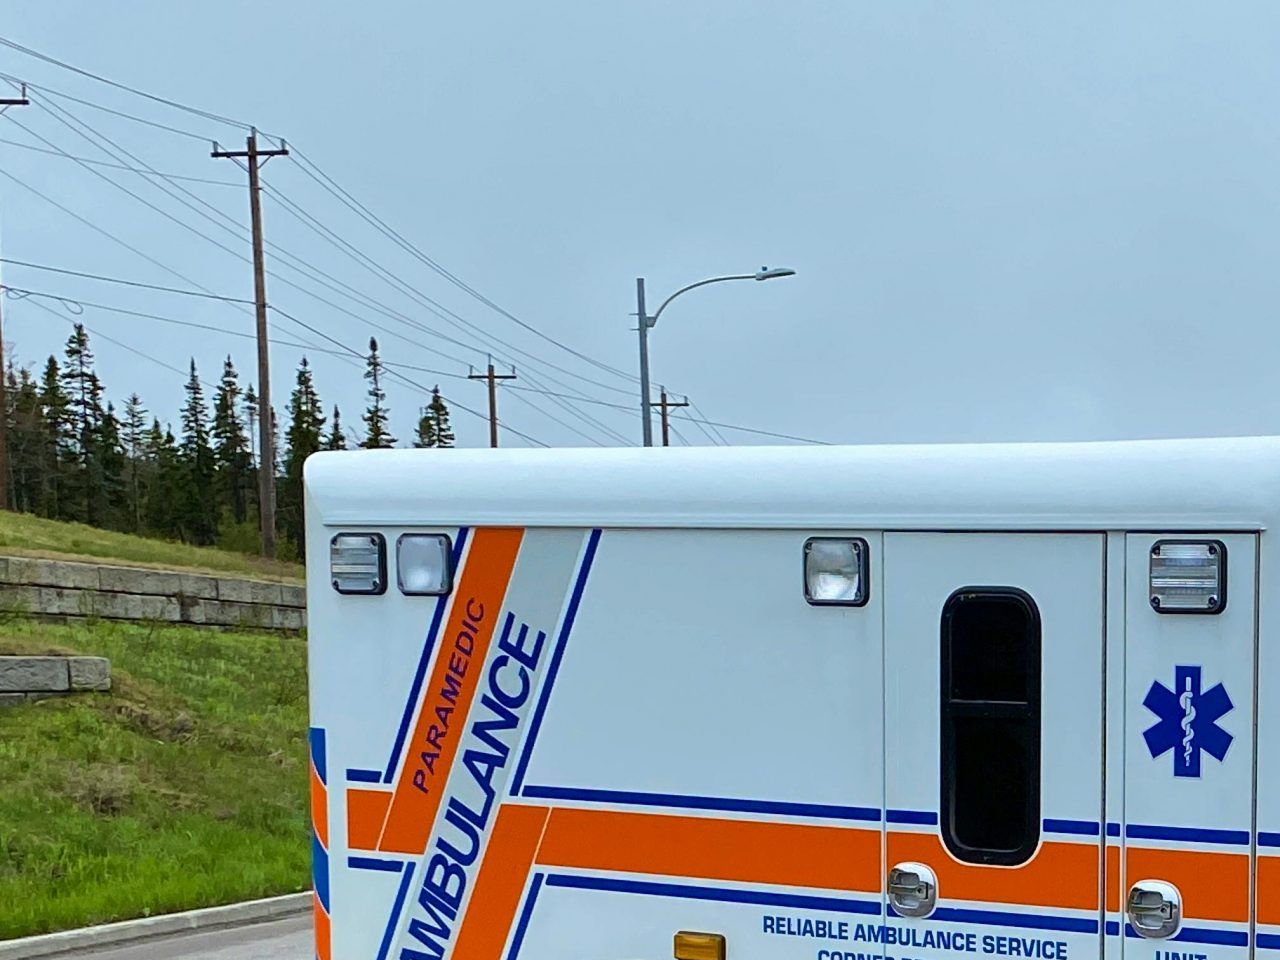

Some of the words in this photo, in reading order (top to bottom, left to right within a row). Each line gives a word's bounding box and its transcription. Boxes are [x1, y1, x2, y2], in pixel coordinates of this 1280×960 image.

[412, 596, 486, 795] PARAMEDIC
[762, 915, 849, 941] RELIABLE
[853, 923, 977, 953] AMBULANCE
[982, 934, 1068, 960] SERVICE
